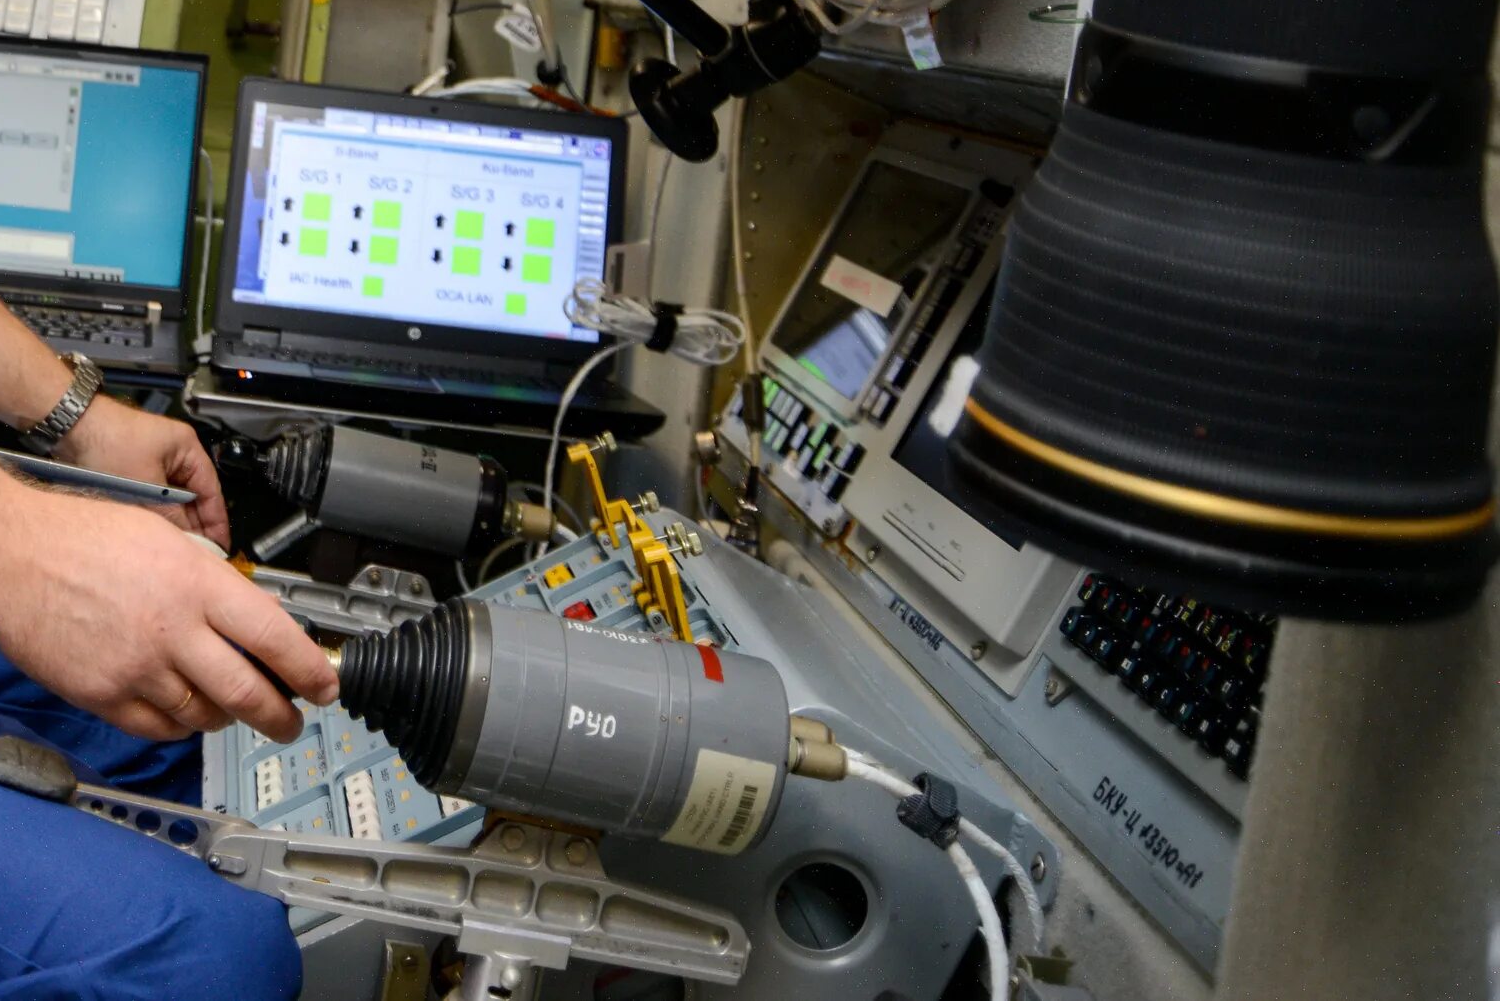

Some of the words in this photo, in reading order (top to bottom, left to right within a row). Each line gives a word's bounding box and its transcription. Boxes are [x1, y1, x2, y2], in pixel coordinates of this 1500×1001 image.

[300, 167, 329, 185] S/G
[368, 175, 399, 192] S/G
[403, 178, 413, 194] 2
[451, 184, 481, 201] S/G
[485, 188, 496, 203] 3
[521, 191, 550, 209] S/G
[313, 275, 353, 290] Health
[467, 291, 494, 306] LAN
[1092, 775, 1142, 835] БКУ-Ц
